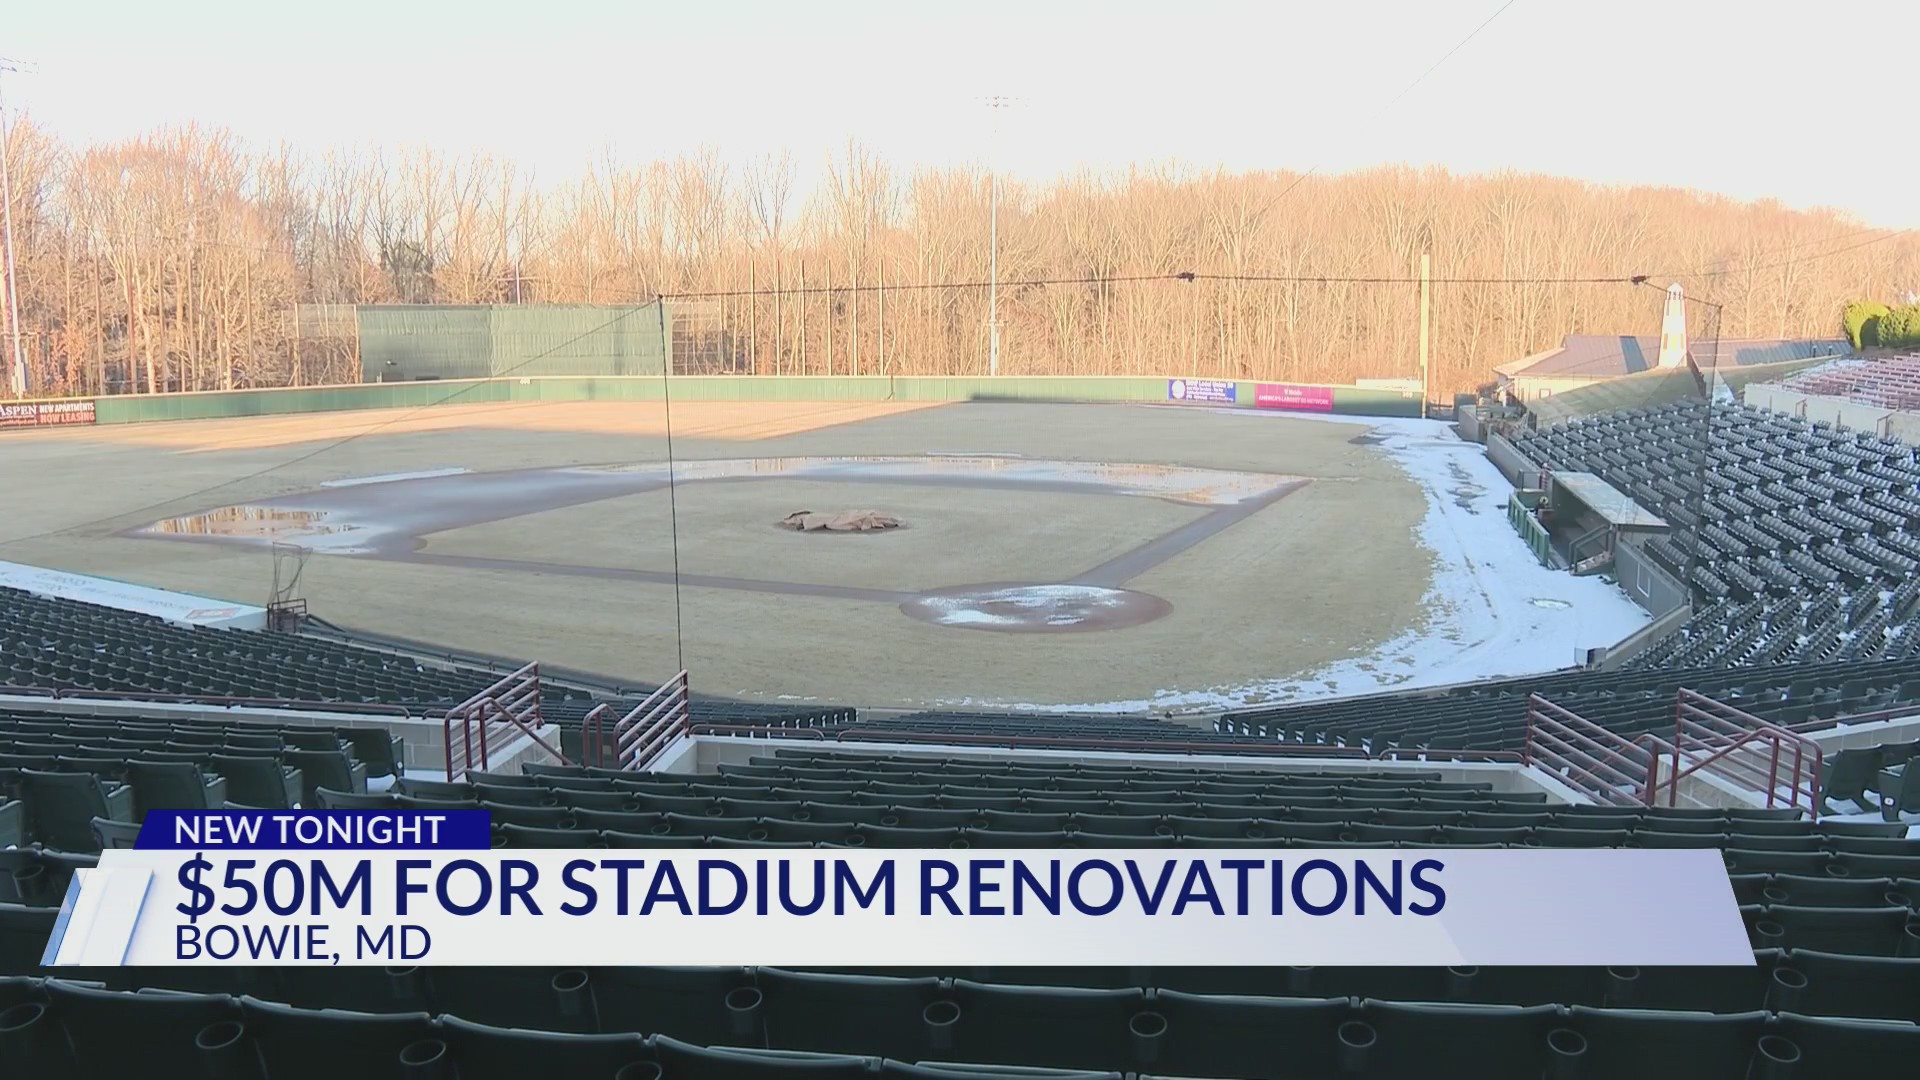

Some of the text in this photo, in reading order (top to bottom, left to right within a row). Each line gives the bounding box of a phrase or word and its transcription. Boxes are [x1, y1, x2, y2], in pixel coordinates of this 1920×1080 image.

[0, 404, 37, 417] ASPEN
[39, 402, 95, 414] NEW APARTMENTS
[40, 412, 61, 424] NOW
[61, 411, 95, 423] LEASING
